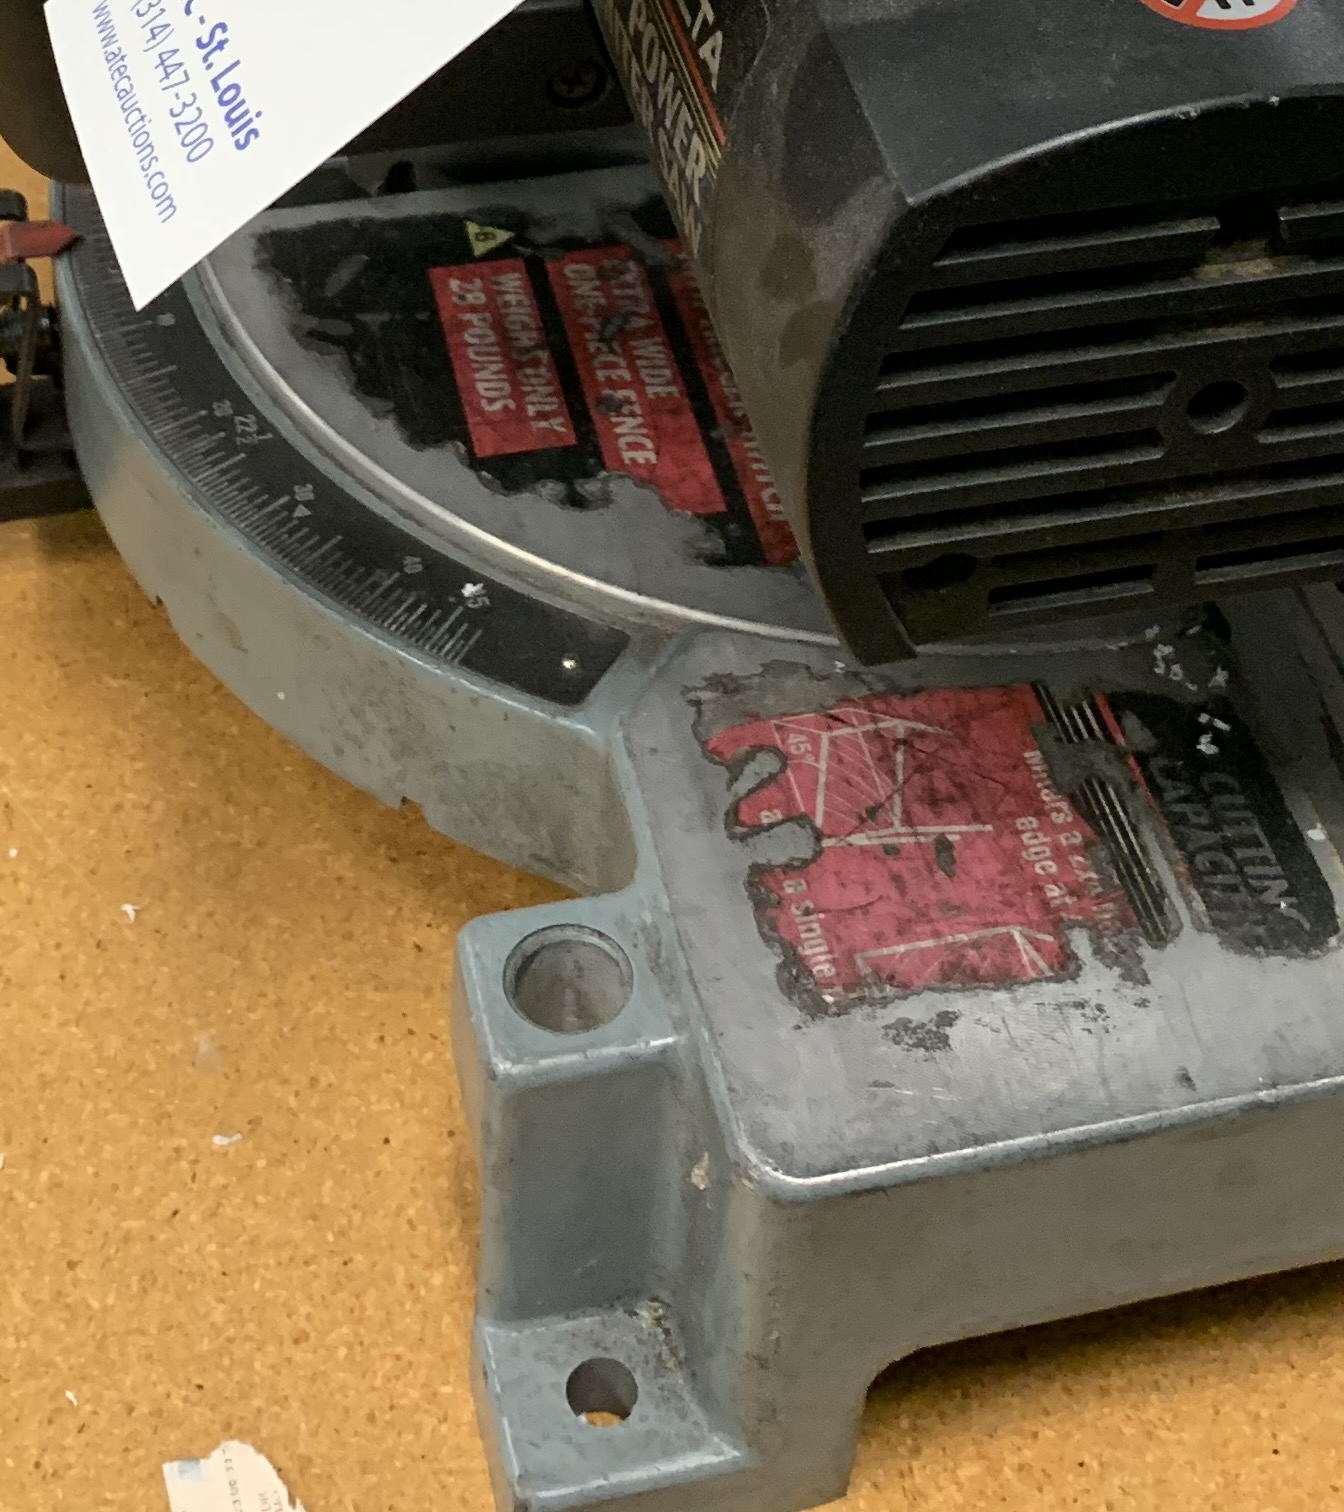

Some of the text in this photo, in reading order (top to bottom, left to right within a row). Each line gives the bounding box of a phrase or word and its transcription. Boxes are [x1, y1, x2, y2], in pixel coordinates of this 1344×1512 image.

[194, 21, 230, 71] St.
[154, 48, 215, 164] 447-3200
[209, 59, 264, 151] Louis
[461, 312, 515, 411] POUNDS
[521, 367, 566, 432] ONLY
[631, 338, 679, 398] WIDE
[604, 389, 656, 464] FENCE
[1016, 816, 1077, 906] edge at
[790, 900, 837, 977] single
